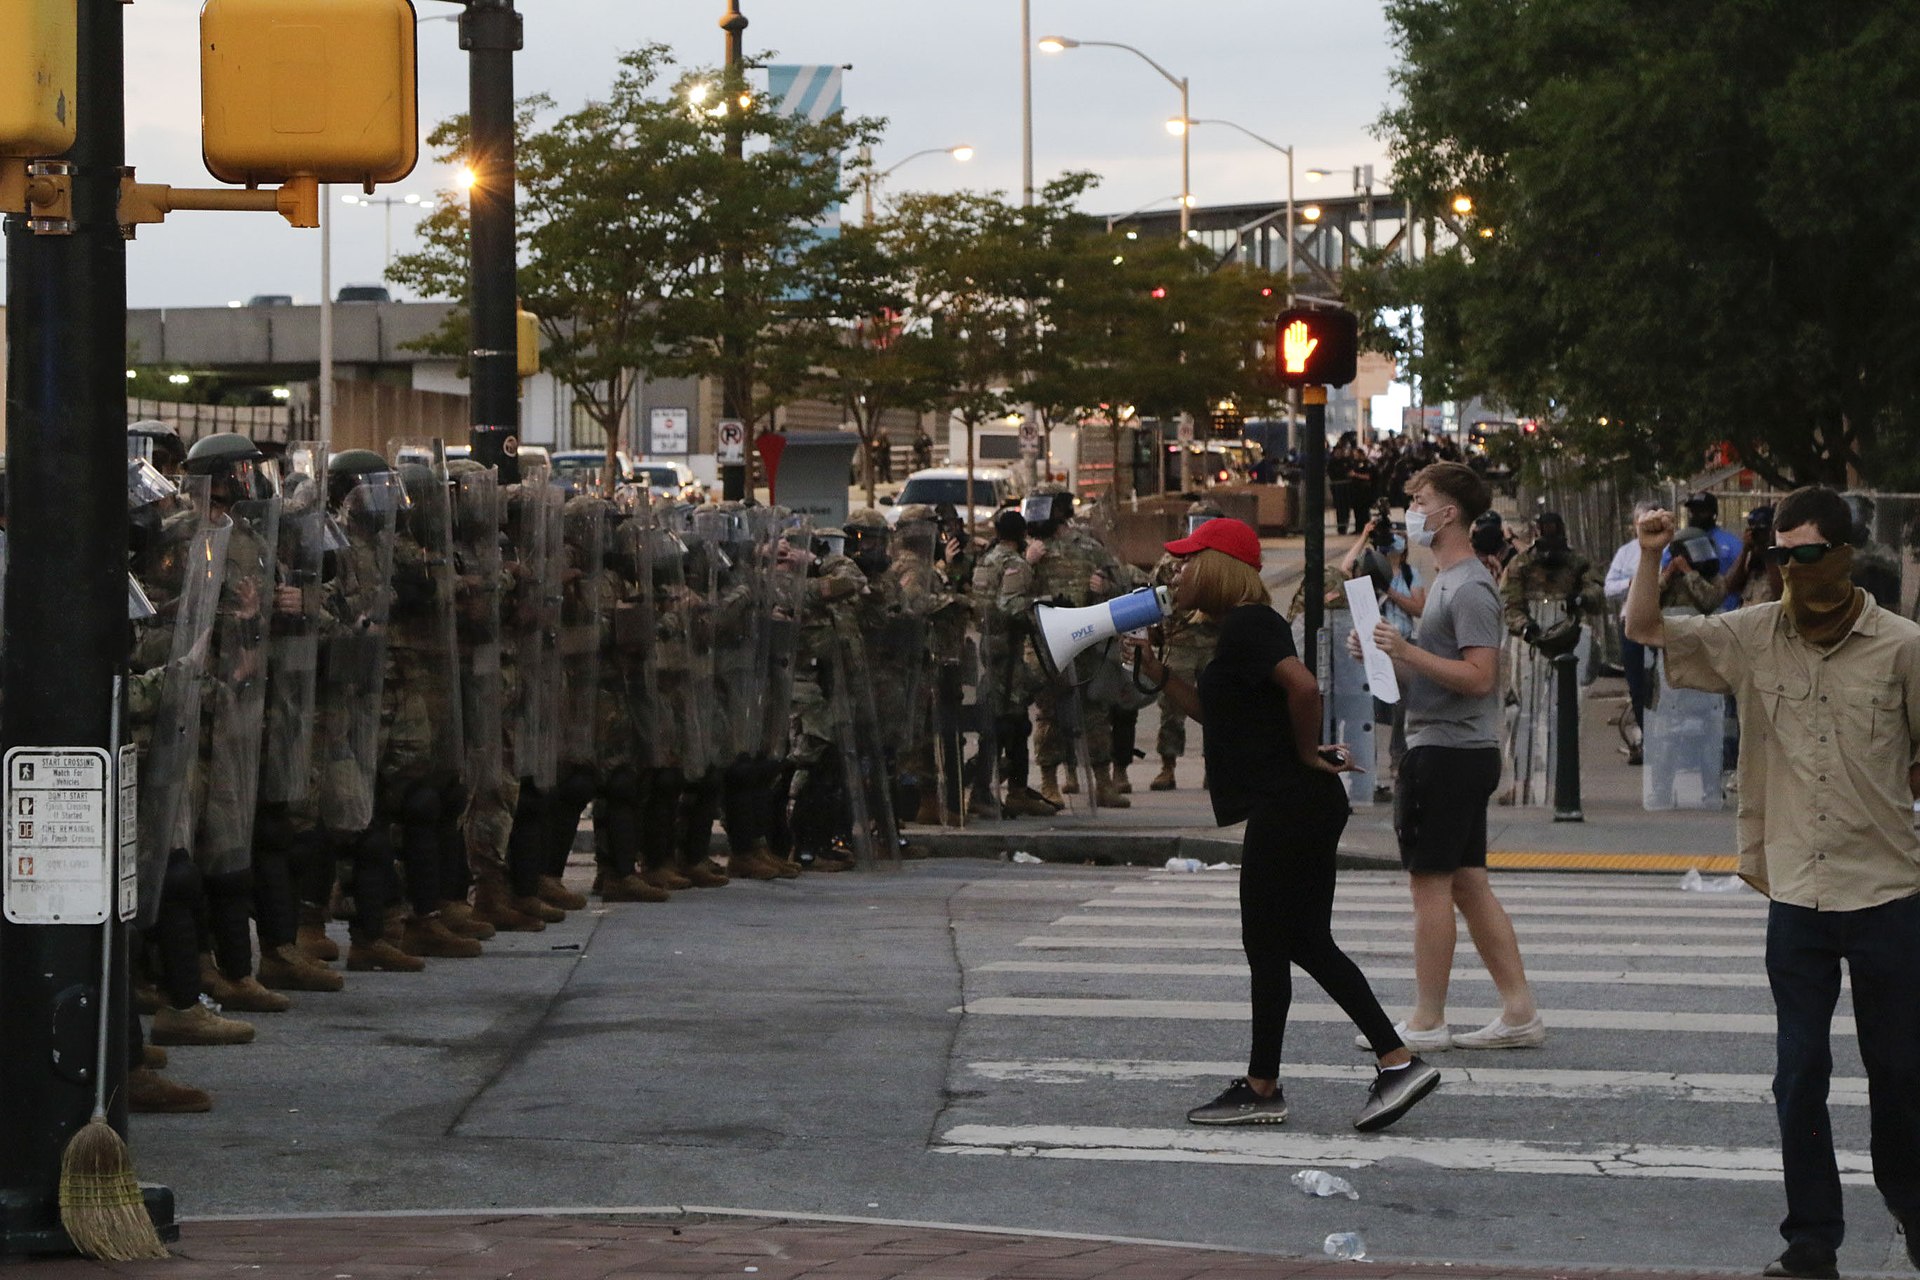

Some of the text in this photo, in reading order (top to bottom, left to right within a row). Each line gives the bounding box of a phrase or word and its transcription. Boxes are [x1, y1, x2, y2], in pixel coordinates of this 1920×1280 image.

[1071, 624, 1094, 639] PYLE
[42, 758, 94, 767] START CROSSING
[53, 769, 83, 777] Watch For
[69, 792, 88, 800] START
